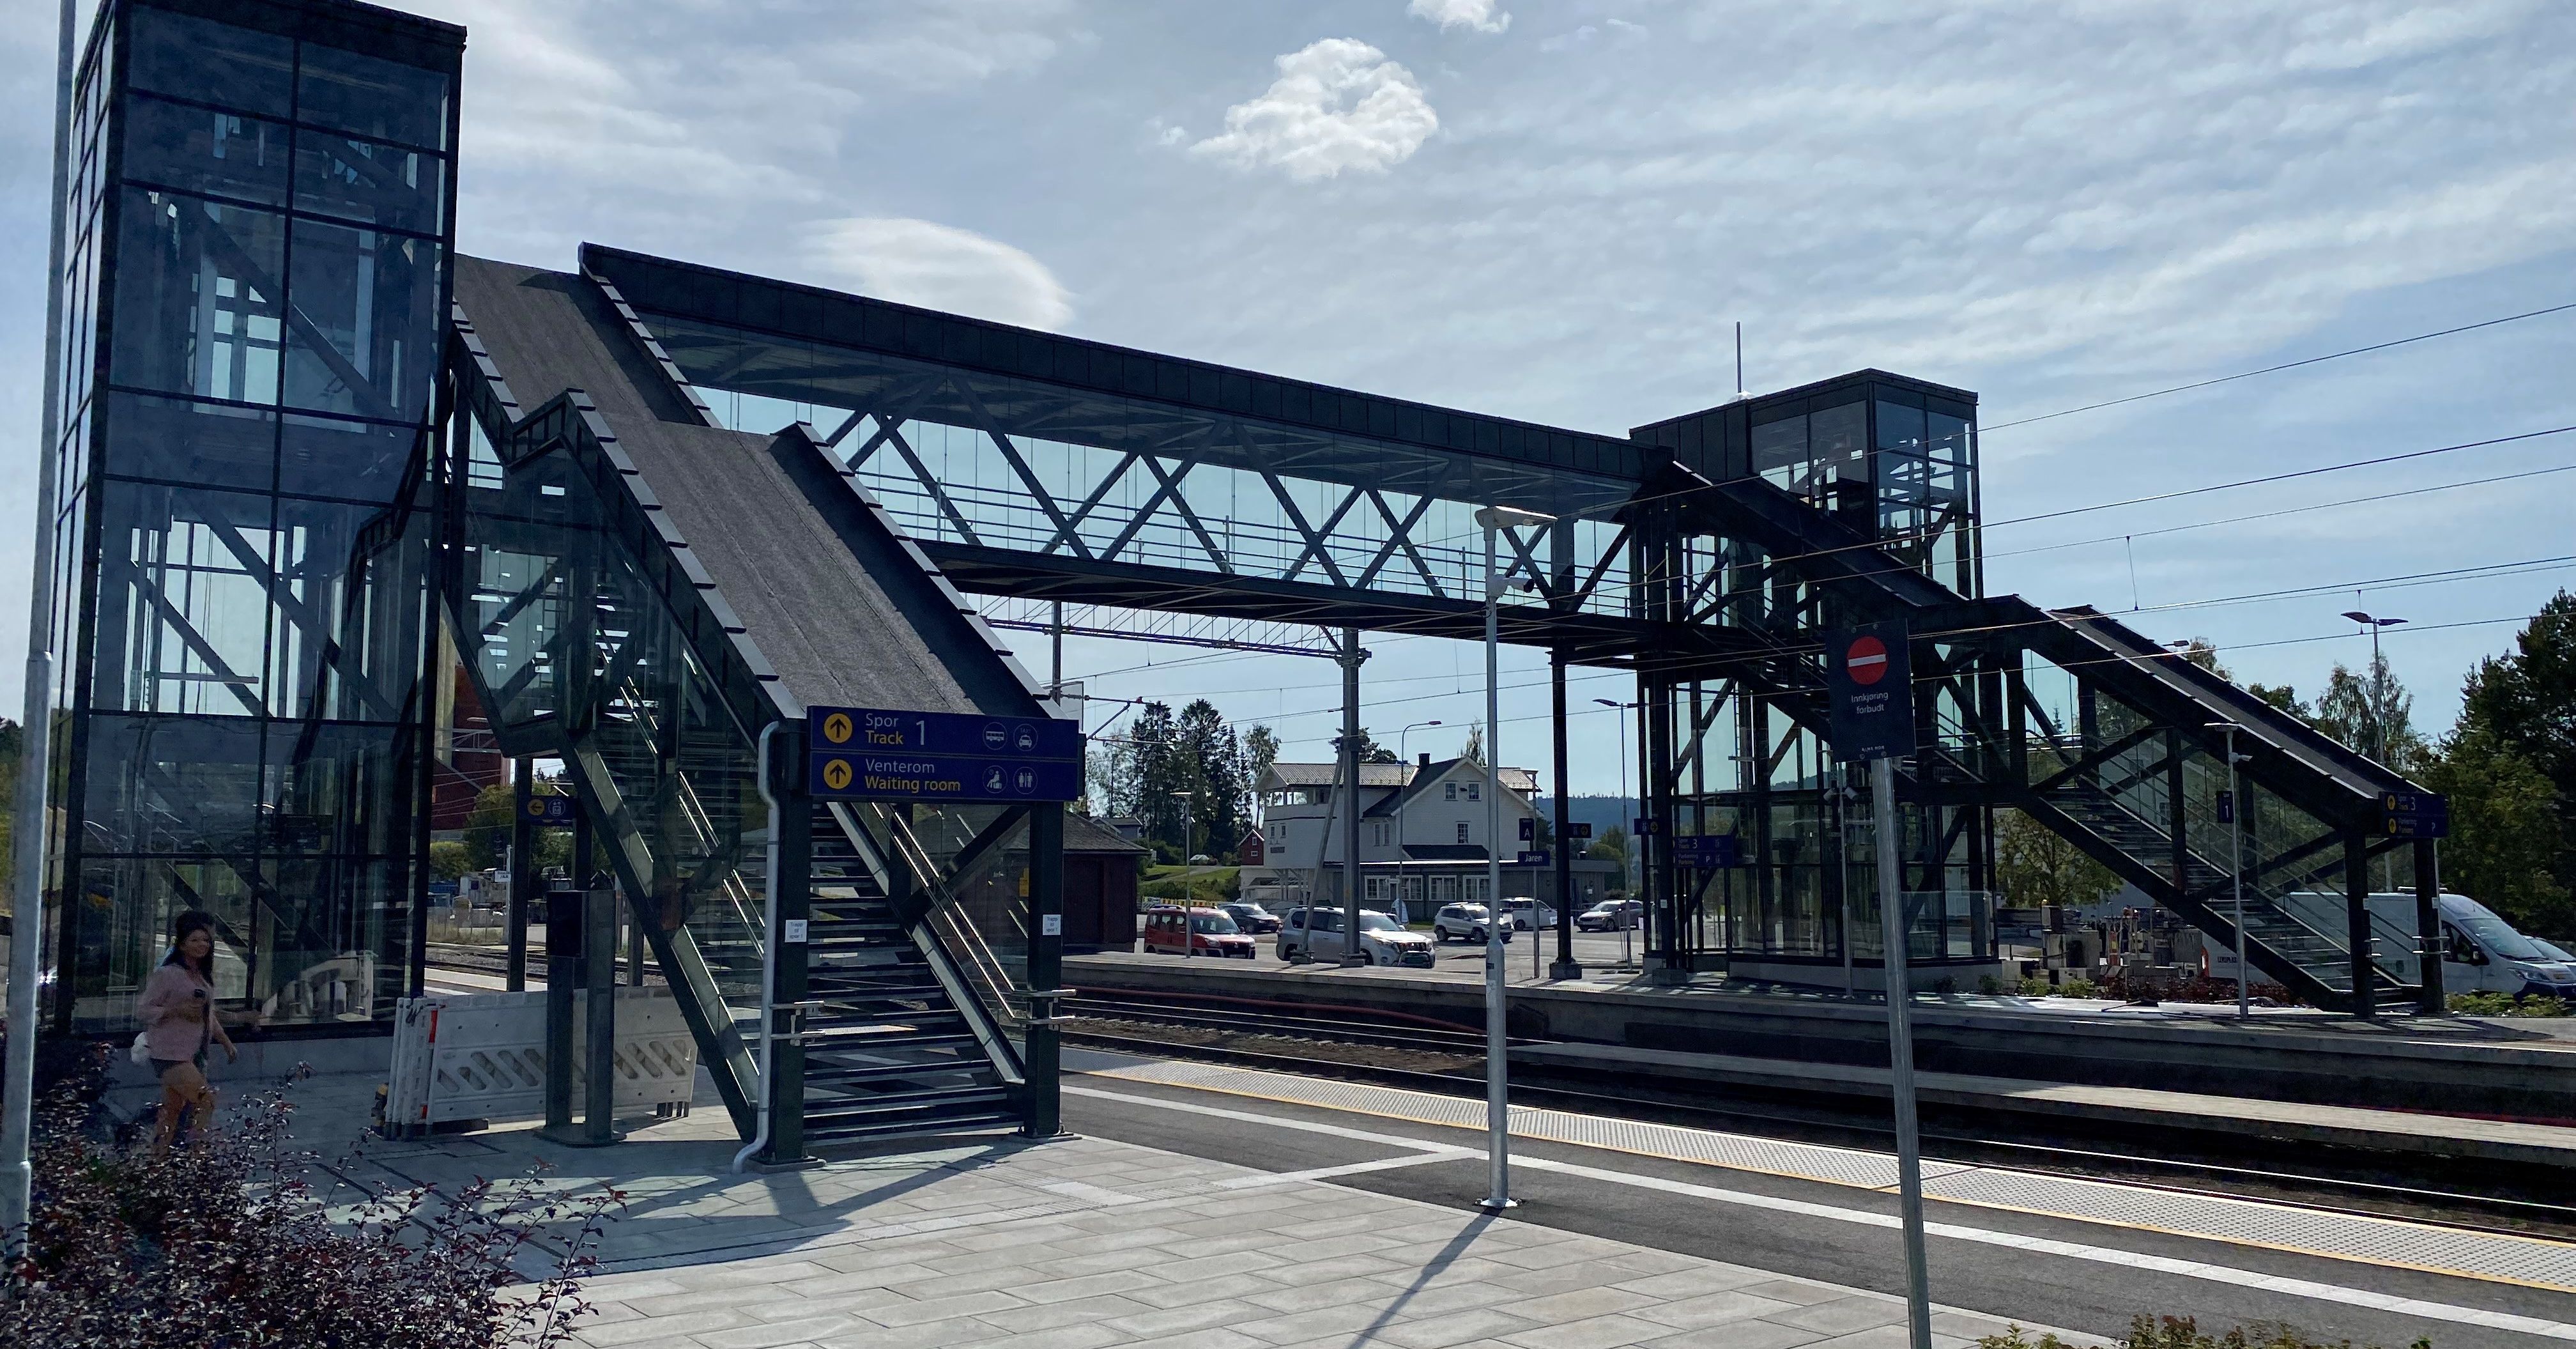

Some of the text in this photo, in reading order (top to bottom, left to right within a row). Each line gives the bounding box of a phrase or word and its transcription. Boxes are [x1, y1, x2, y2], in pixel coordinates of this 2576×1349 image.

[1851, 692, 1889, 703] Innkjøring
[1857, 703, 1885, 714] forbudt
[865, 713, 924, 745] Spor 1
[865, 730, 903, 745] Track
[865, 758, 935, 773] Venterom
[864, 775, 961, 794] Waiting room
[2411, 796, 2416, 811] 3
[2225, 805, 2229, 818] 1
[1524, 828, 1531, 838] A
[1692, 838, 1698, 849] 3
[1524, 853, 1543, 862] Jaren
